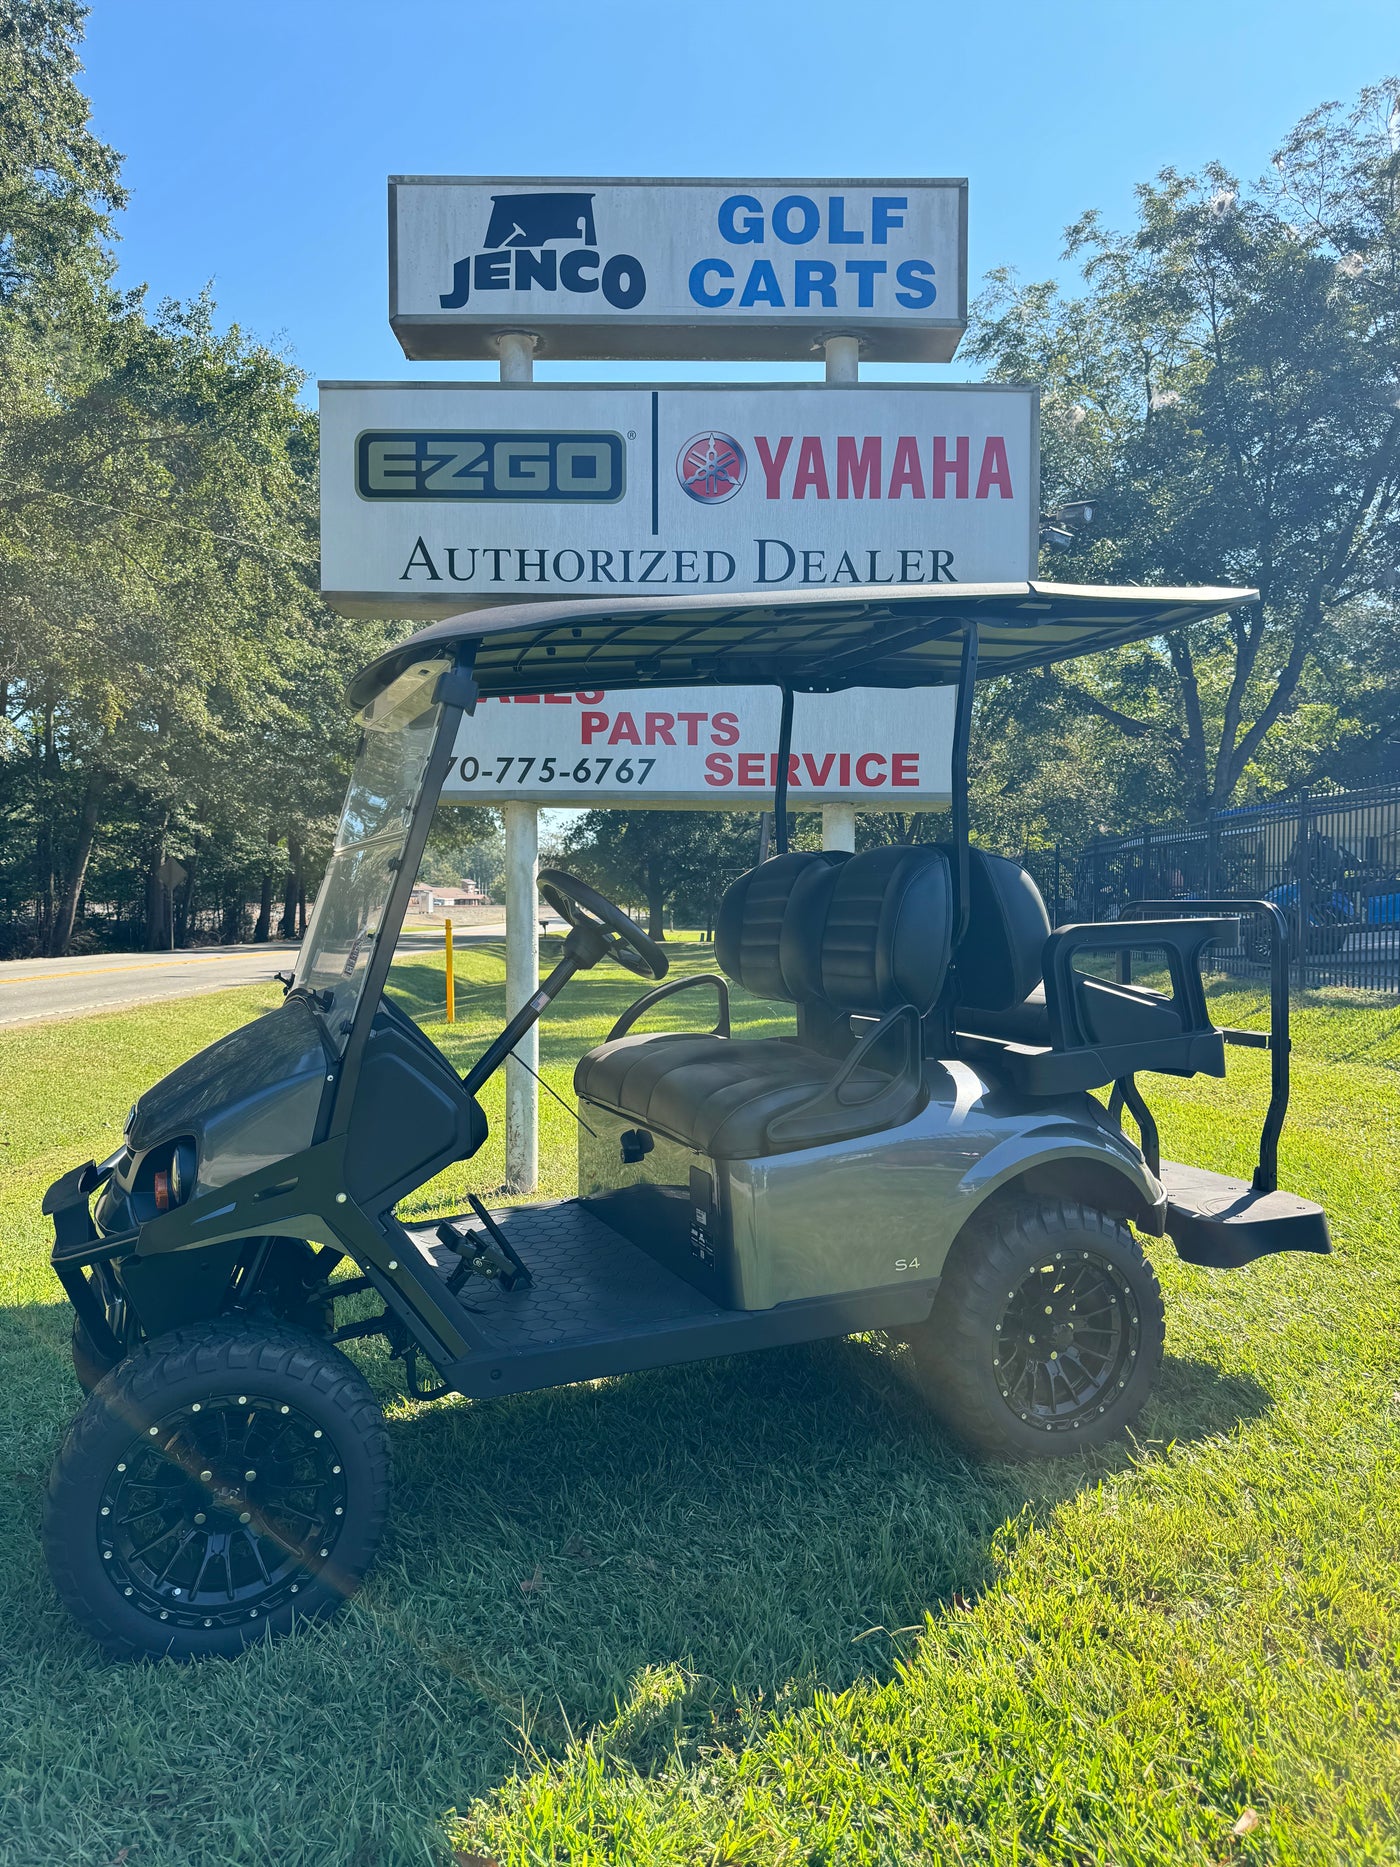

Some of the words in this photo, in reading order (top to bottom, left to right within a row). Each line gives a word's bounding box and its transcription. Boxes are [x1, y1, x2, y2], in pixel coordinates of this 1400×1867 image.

[717, 195, 908, 244] GOLF
[440, 249, 647, 309] JENCO
[688, 258, 938, 309] CARTS
[368, 440, 612, 492] EZGO
[753, 436, 1014, 500] YAMAHA
[399, 536, 736, 584] AUTHORIZED
[753, 539, 959, 583] DEALER
[581, 711, 740, 746] PARTS
[704, 752, 920, 787] SERVICE
[895, 1256, 920, 1271] S4
